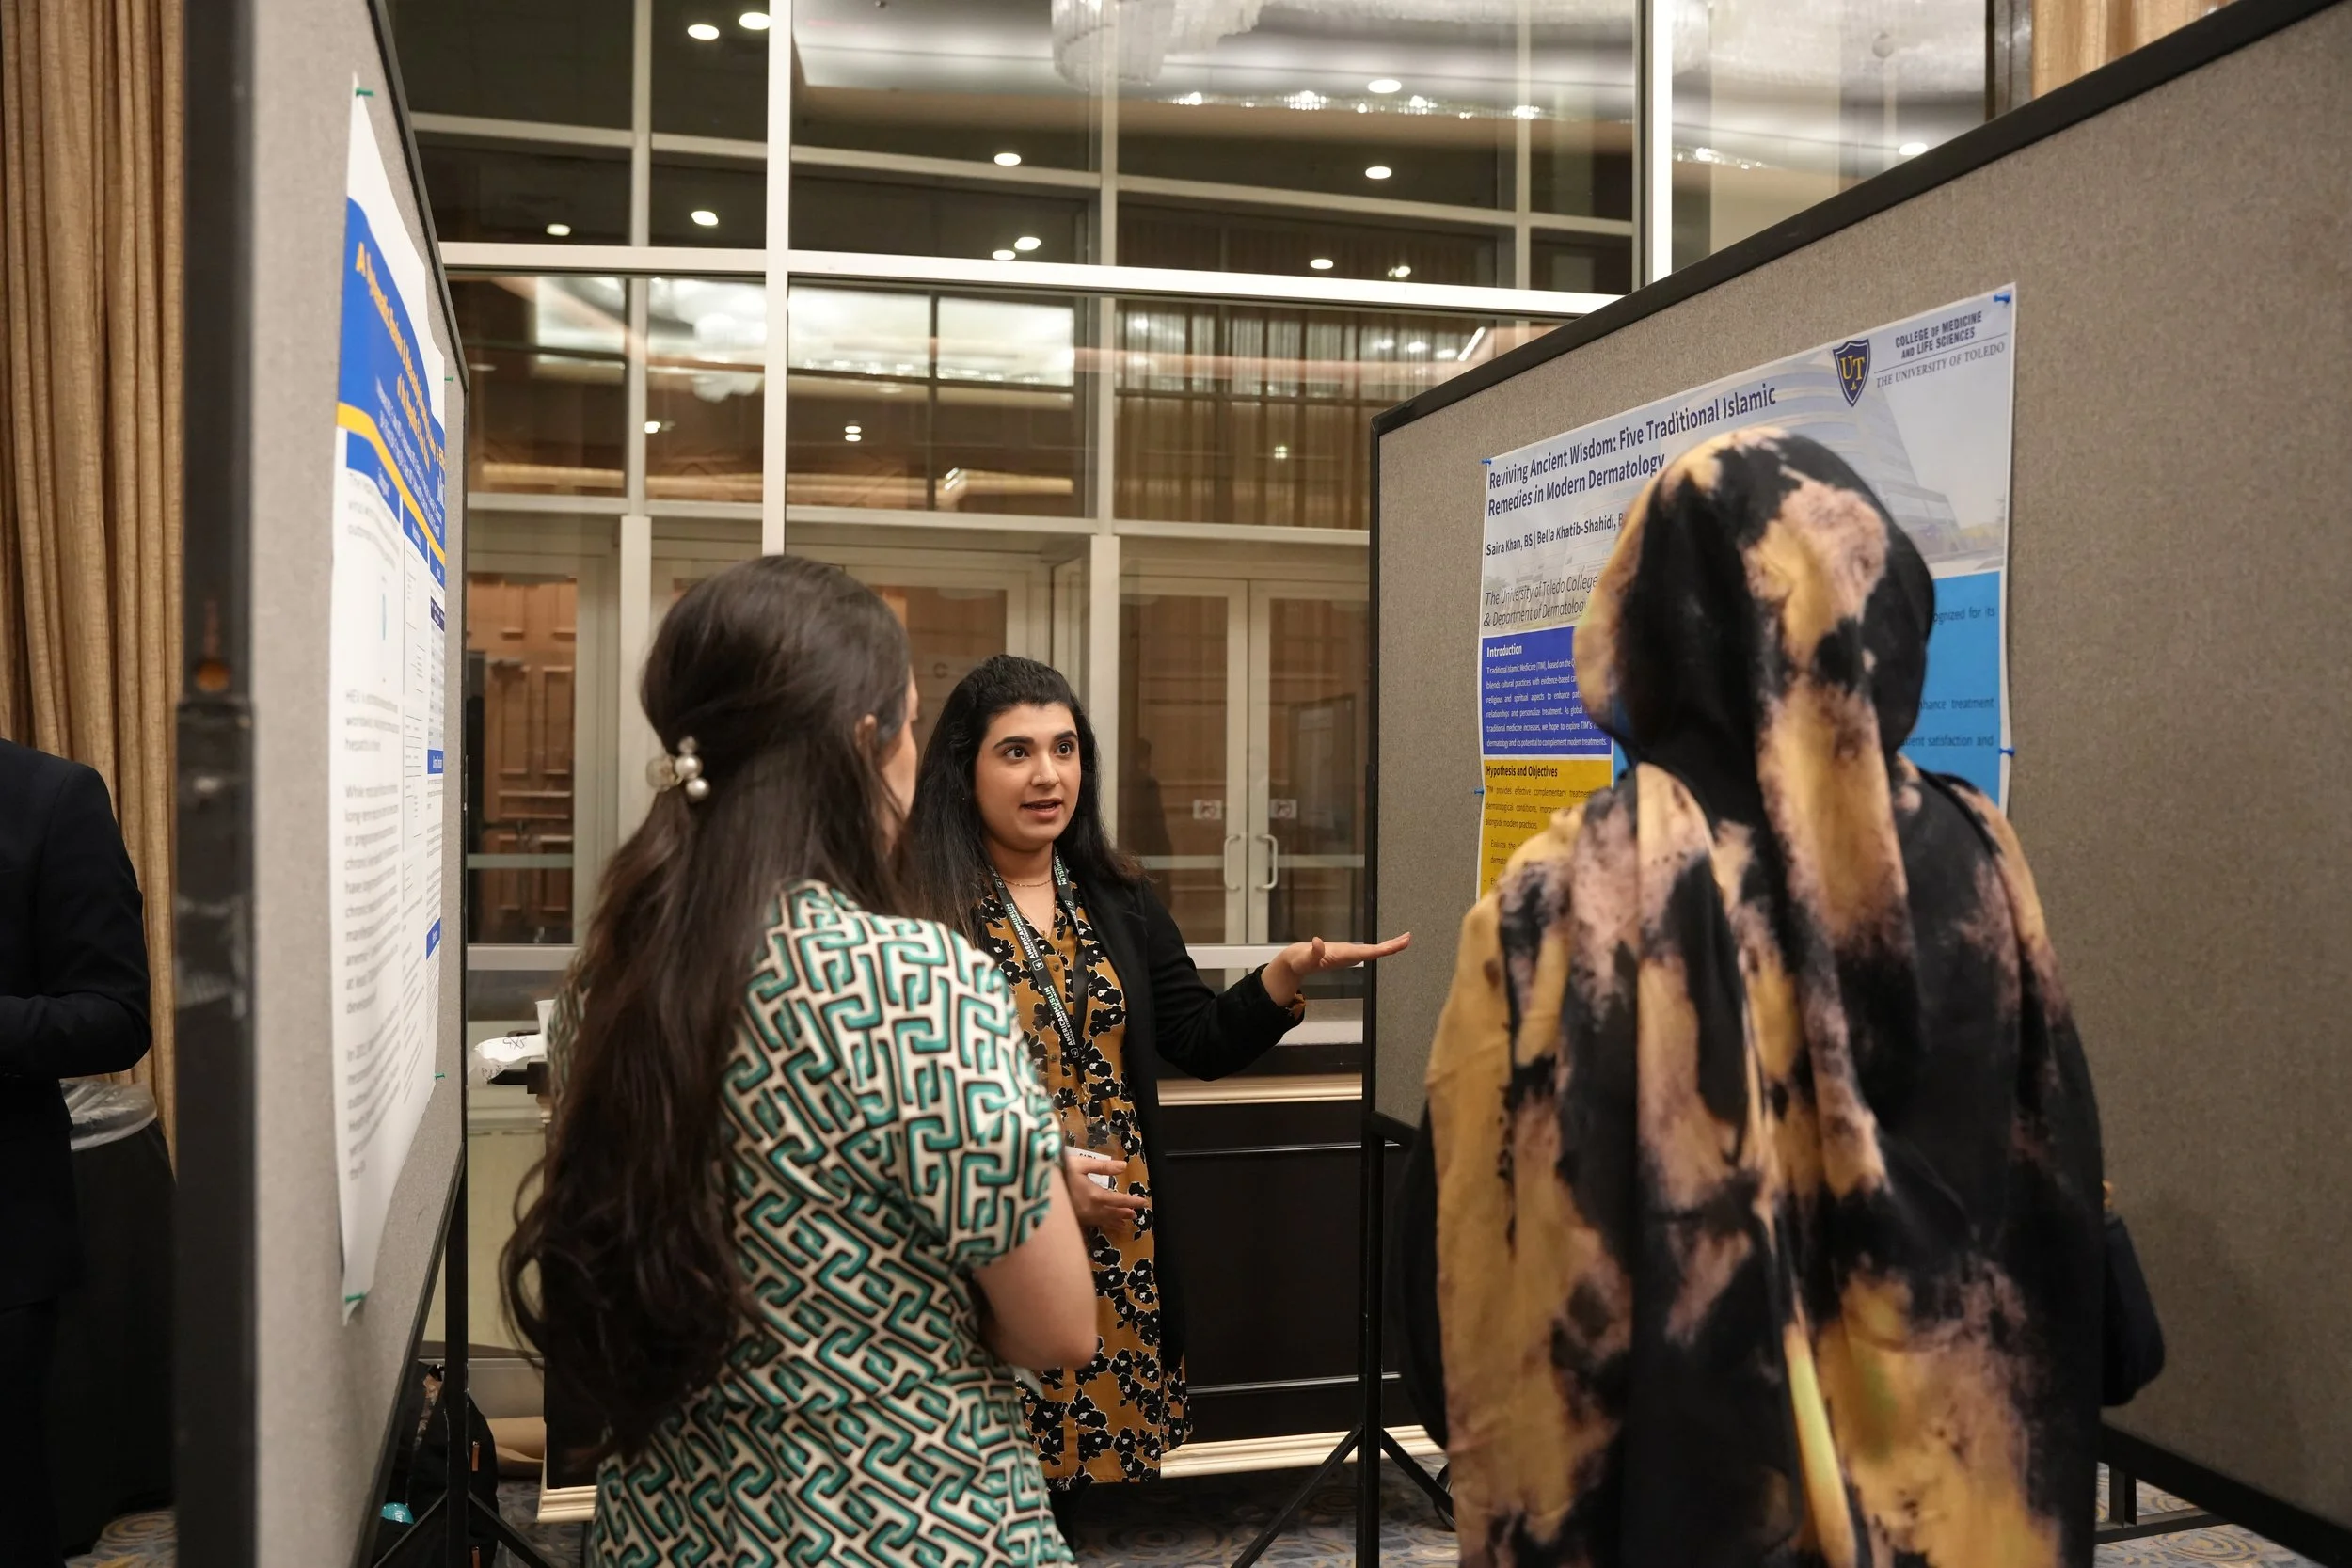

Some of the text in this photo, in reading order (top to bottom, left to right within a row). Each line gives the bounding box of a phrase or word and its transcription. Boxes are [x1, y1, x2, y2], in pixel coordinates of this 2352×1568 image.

[1896, 311, 1982, 348] COLLEGE OF MEDICINE
[1901, 326, 1975, 359] AND LIFE SCIENCES
[1840, 355, 1866, 381] UT
[1876, 341, 2005, 388] THE UNIVERSITY OF TOLEDO
[1489, 383, 1776, 490] Reviving Ancient Wisdom: Five Traditional Islamic
[1488, 453, 1665, 517] Remedies in Modern Dermatology
[1486, 542, 1504, 556] Saira
[1505, 537, 1522, 551] Khan,
[1524, 533, 1533, 547] BS
[1537, 529, 1553, 545] Bella
[1556, 513, 1616, 542] Khatib-Shahidi,
[1485, 573, 1598, 606] The University of Toledo College
[1483, 612, 1491, 627] &
[1492, 609, 1533, 628] Department
[1534, 603, 1542, 619] of
[1969, 607, 1981, 619] for
[1985, 606, 1994, 617] its
[1486, 643, 1522, 657] Introduction
[1519, 662, 1536, 672] Medicine
[1548, 659, 1559, 669] based
[1486, 680, 1501, 689] blends
[1501, 679, 1515, 689] cultural
[1515, 678, 1532, 689] practices
[1532, 676, 1540, 686] with
[1540, 674, 1570, 685] evidence-based
[1486, 695, 1503, 705] religious
[1514, 692, 1529, 704] spiritual
[1531, 692, 1545, 703] aspects
[1553, 690, 1570, 700] enhance
[1951, 698, 1994, 709] treatment
[1486, 709, 1510, 719] relationships
[1519, 707, 1541, 719] personalize
[1541, 706, 1563, 716] treatment.
[1570, 705, 1583, 717] global
[1486, 723, 1506, 733] traditional
[1506, 723, 1522, 732] medicine
[1549, 722, 1560, 734] hope
[1565, 721, 1580, 733] explore
[1581, 721, 1593, 730] TIM's
[1508, 738, 1517, 747] and
[1542, 738, 1567, 748] complement
[1567, 737, 1581, 746] modern
[1581, 737, 1607, 746] treatments.
[1928, 734, 1973, 747] satisfaction
[1977, 735, 1994, 747] and
[1486, 765, 1558, 780] Hypothesis and Objectives
[1496, 786, 1512, 796] provides
[1515, 786, 1532, 796] effective
[1534, 788, 1566, 799] complementary
[1486, 817, 1503, 829] alongside
[1502, 819, 1518, 828] modern
[1005, 902, 1036, 959] AMERICANMUSLIM
[1042, 985, 1073, 1045] AMERICANMUSLIM
